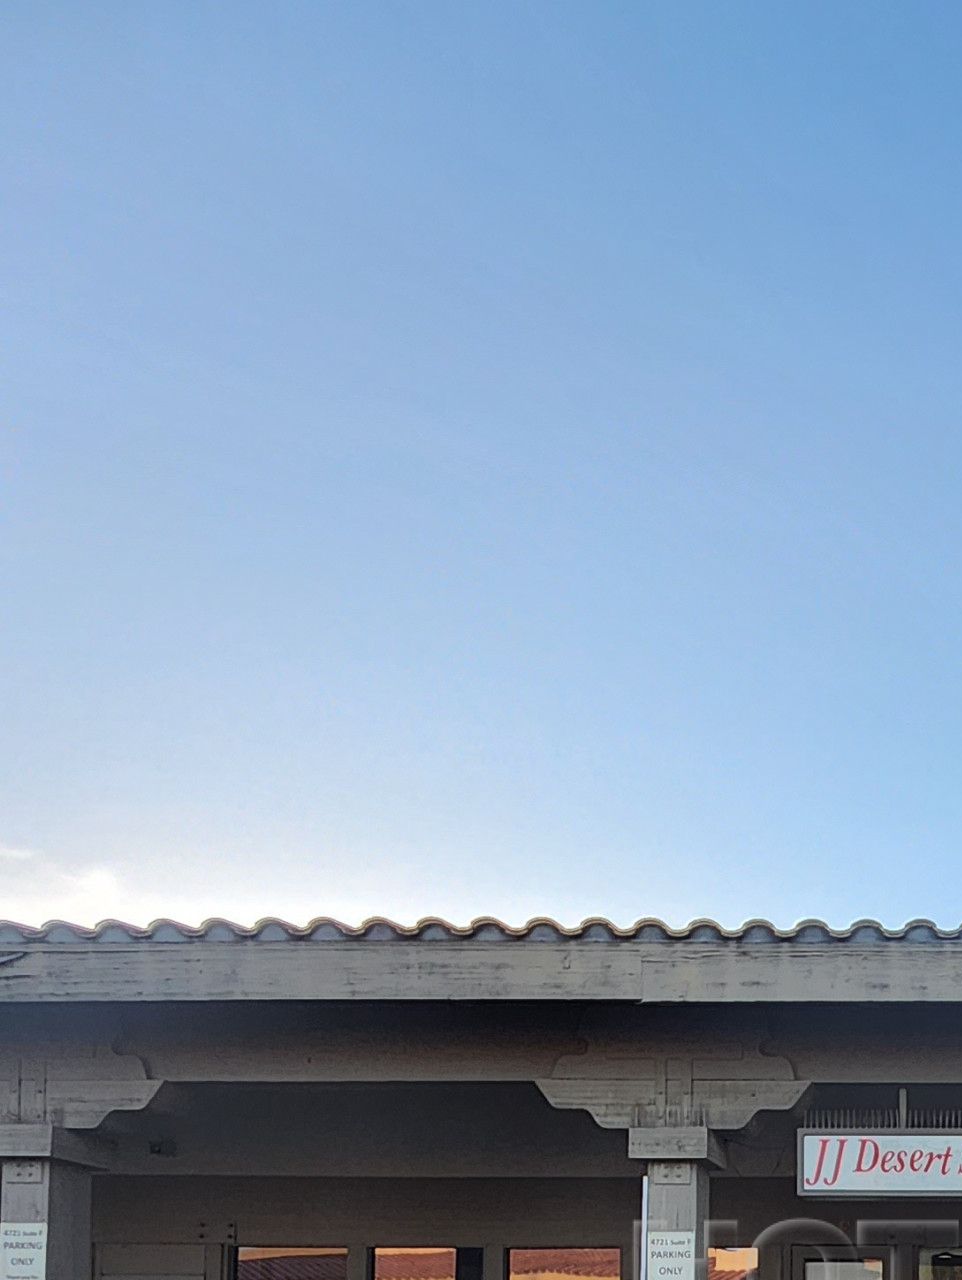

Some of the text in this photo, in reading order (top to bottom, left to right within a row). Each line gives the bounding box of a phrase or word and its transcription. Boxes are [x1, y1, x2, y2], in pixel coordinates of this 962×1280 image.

[806, 1138, 847, 1186] JJ
[852, 1138, 952, 1176] Desert
[651, 1251, 691, 1259] PARKING
[659, 1267, 683, 1275] ONLY
